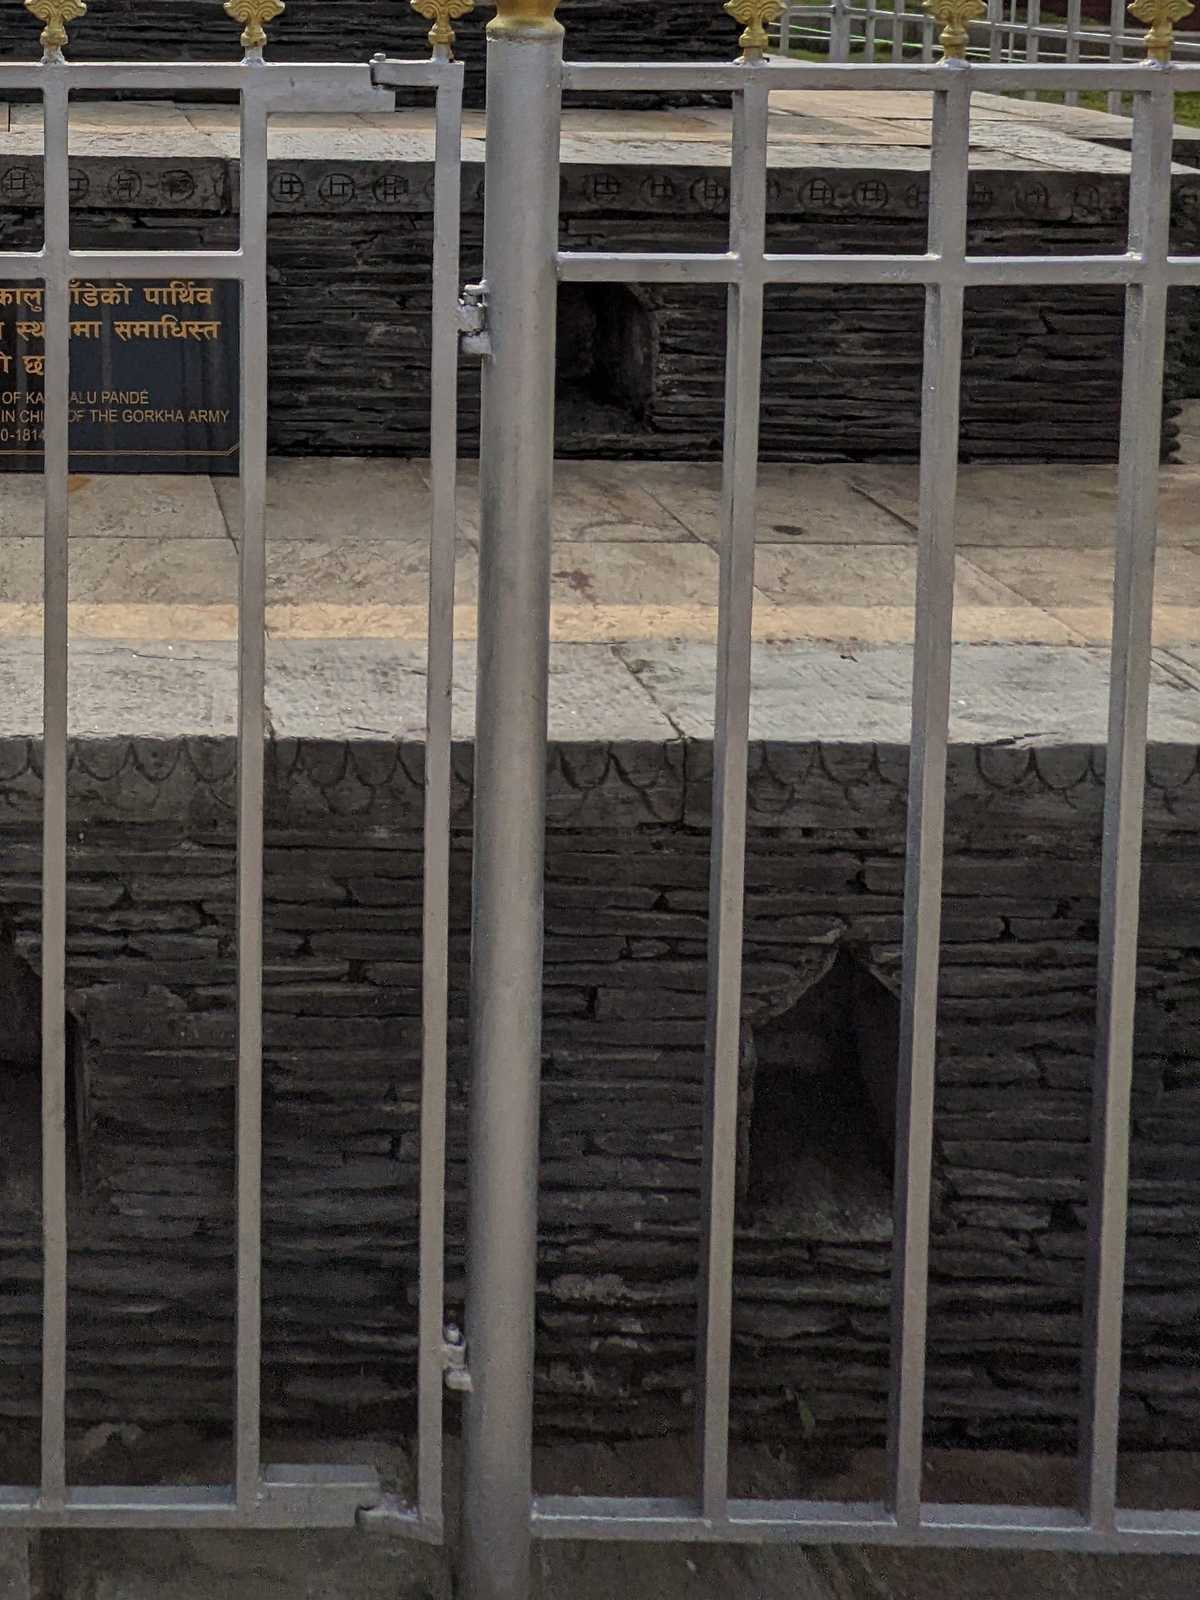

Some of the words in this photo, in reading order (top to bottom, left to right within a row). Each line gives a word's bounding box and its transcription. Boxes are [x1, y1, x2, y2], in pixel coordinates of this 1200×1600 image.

[58, 280, 133, 307] ाँडेको
[143, 280, 214, 307] पार्थिव
[2, 391, 22, 405] OF
[63, 391, 97, 404] ALU
[1, 410, 16, 423] IN
[19, 409, 58, 423] CHI
[90, 409, 118, 423] THE
[122, 409, 185, 423] GORKHA
[188, 409, 230, 423] ARMY
